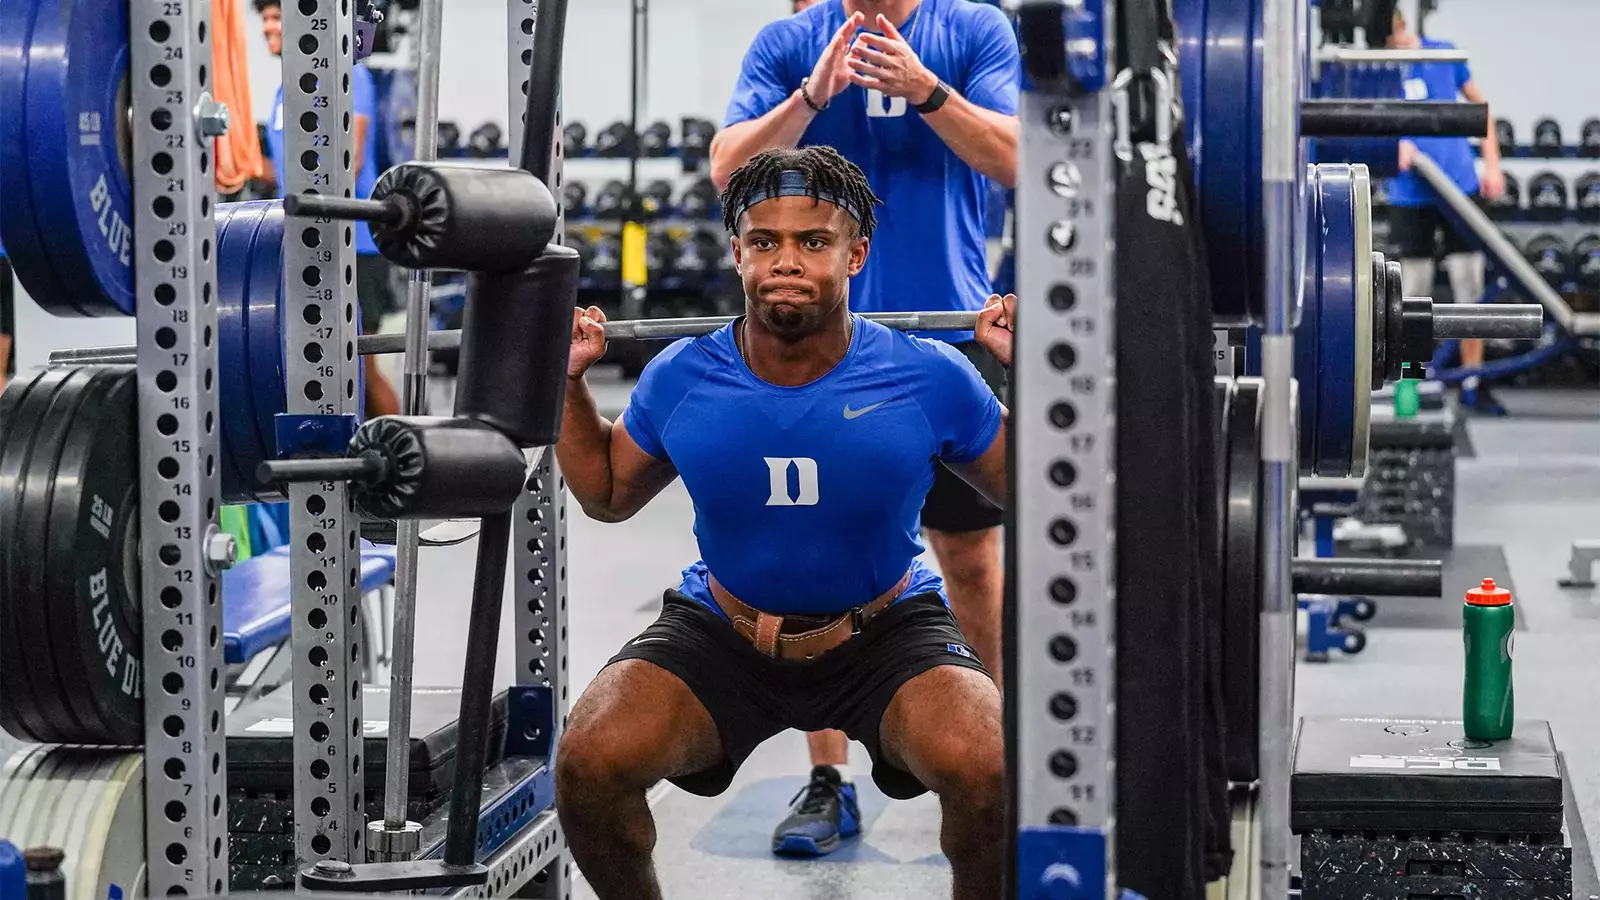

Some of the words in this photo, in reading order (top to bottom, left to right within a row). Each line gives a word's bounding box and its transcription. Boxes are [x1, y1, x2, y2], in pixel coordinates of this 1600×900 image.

[163, 3, 182, 16] 25
[311, 19, 328, 31] 25
[164, 47, 183, 60] 24
[311, 58, 329, 69] 24
[165, 91, 183, 104] 23
[167, 178, 185, 191] 21
[90, 172, 132, 268] BLUE
[168, 222, 187, 236] 20
[316, 250, 332, 262] 19
[171, 266, 188, 279] 19
[316, 289, 333, 300] 18
[172, 310, 189, 323] 18
[316, 327, 333, 339] 17
[172, 353, 189, 367] 17
[317, 365, 334, 377] 16
[171, 397, 190, 410] 16
[318, 404, 334, 415] 15
[172, 440, 191, 453] 15
[320, 481, 335, 491] 13
[764, 457, 819, 505] D
[173, 484, 192, 496] 14
[319, 518, 336, 530] 12
[174, 527, 192, 540] 13
[320, 556, 336, 568] 11
[175, 570, 193, 583] 12
[321, 594, 338, 606] 10
[90, 567, 123, 677] BLUE
[176, 613, 194, 626] 11
[325, 632, 335, 643] 9
[177, 656, 195, 669] 10
[326, 670, 335, 681] 8
[181, 699, 191, 711] 9
[327, 708, 336, 719] 7
[182, 742, 192, 754] 8
[327, 745, 336, 756] 6
[183, 784, 193, 796] 7
[328, 783, 337, 794] 5
[328, 820, 338, 831] 4
[184, 827, 193, 839] 6
[184, 869, 194, 882] 5
